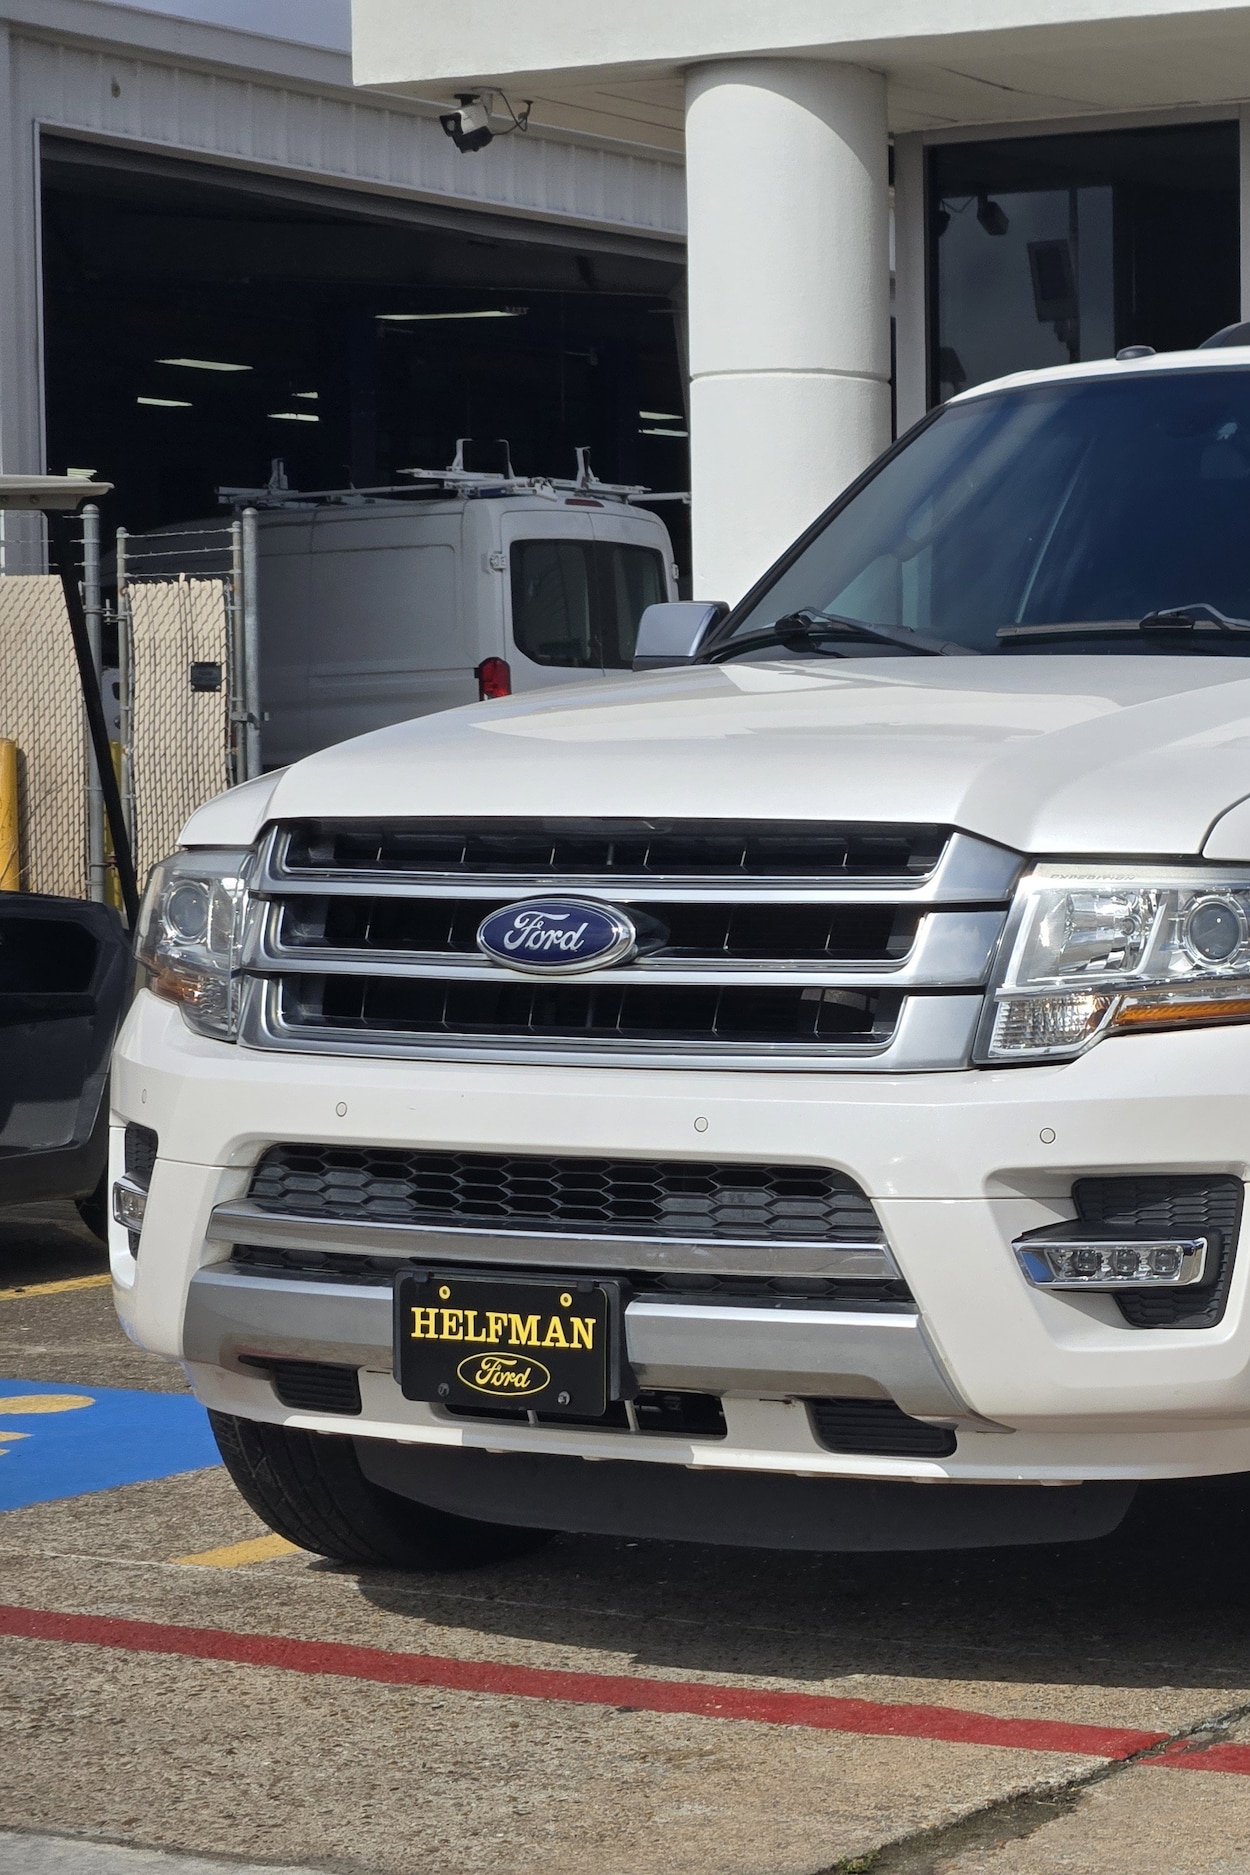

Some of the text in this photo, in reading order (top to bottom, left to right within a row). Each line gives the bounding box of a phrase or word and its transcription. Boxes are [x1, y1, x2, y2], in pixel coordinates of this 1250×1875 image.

[503, 911, 589, 951] Ford
[410, 1306, 597, 1350] HELFMAN
[475, 1356, 532, 1388] Ford
